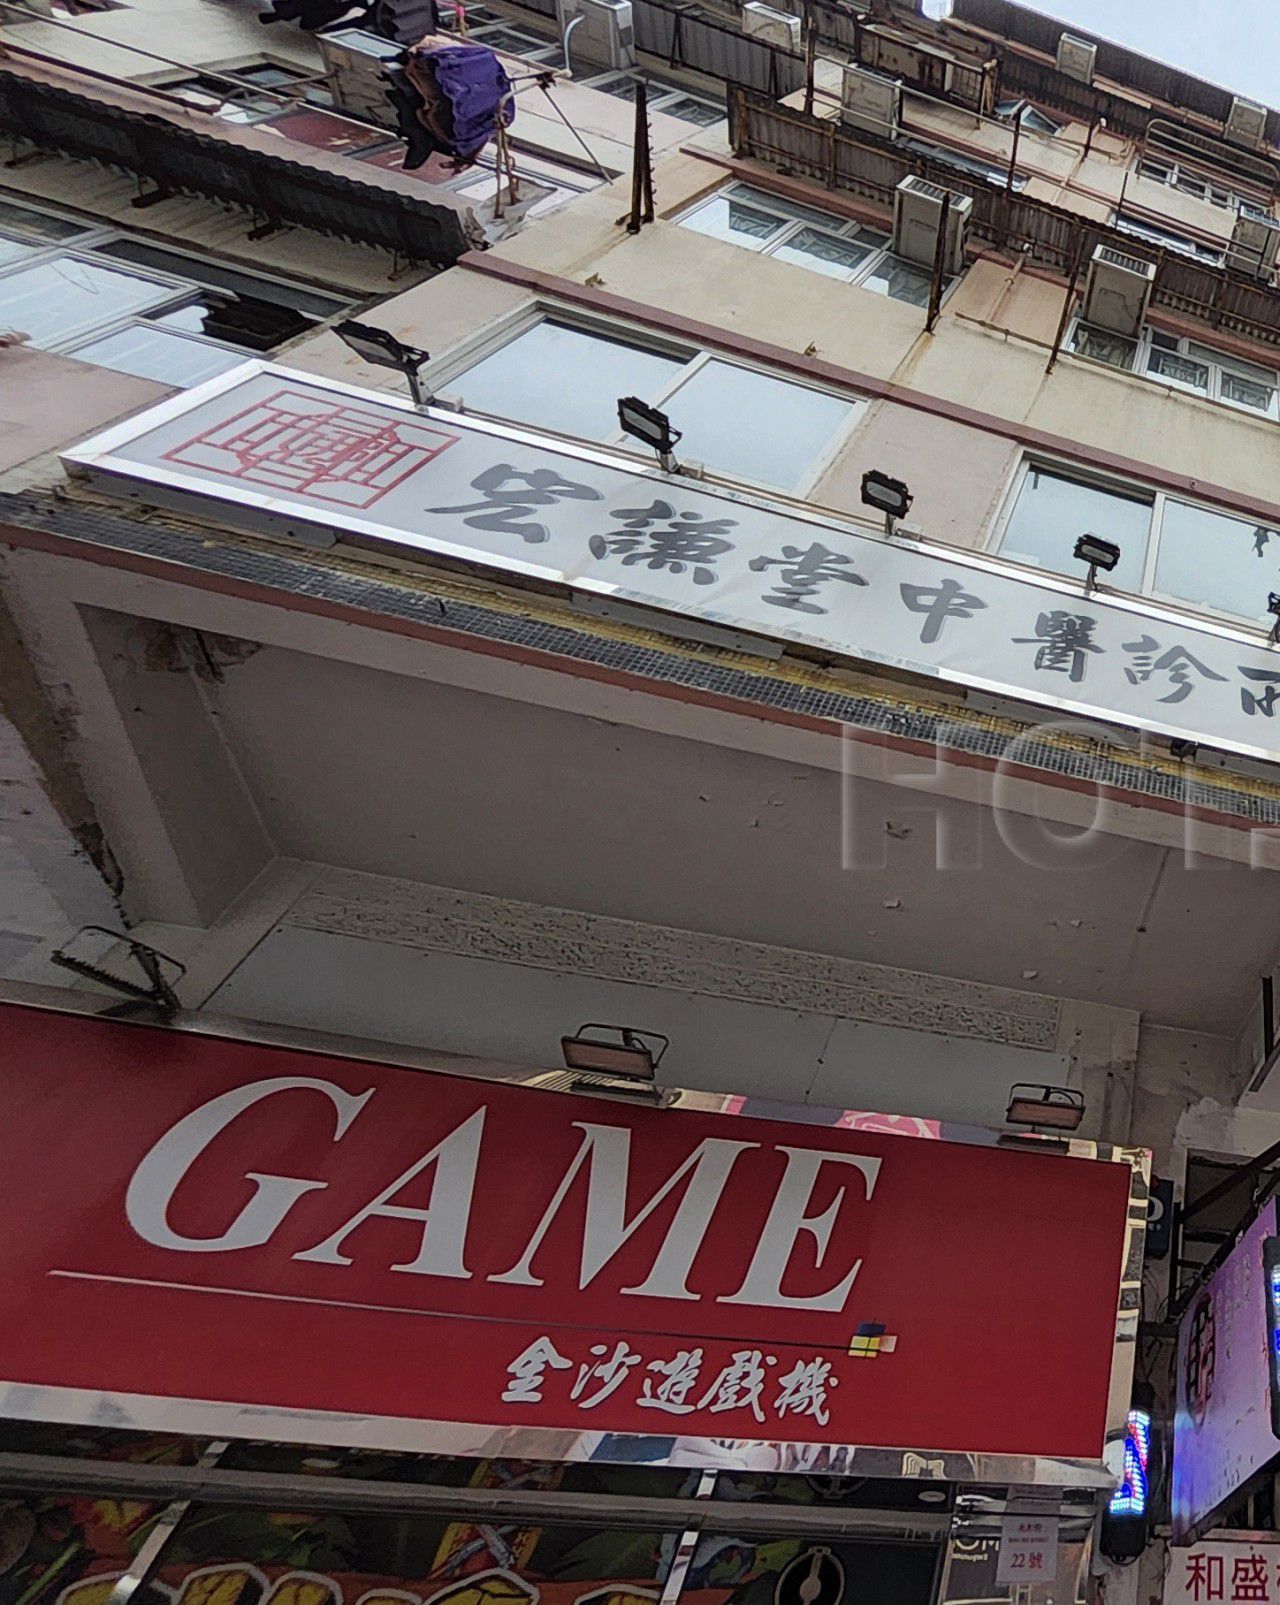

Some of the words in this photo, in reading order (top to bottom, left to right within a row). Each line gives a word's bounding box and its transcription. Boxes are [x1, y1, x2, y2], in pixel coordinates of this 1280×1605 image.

[125, 1076, 883, 1313] GAME
[500, 1336, 838, 1426] 金沙遊戲機
